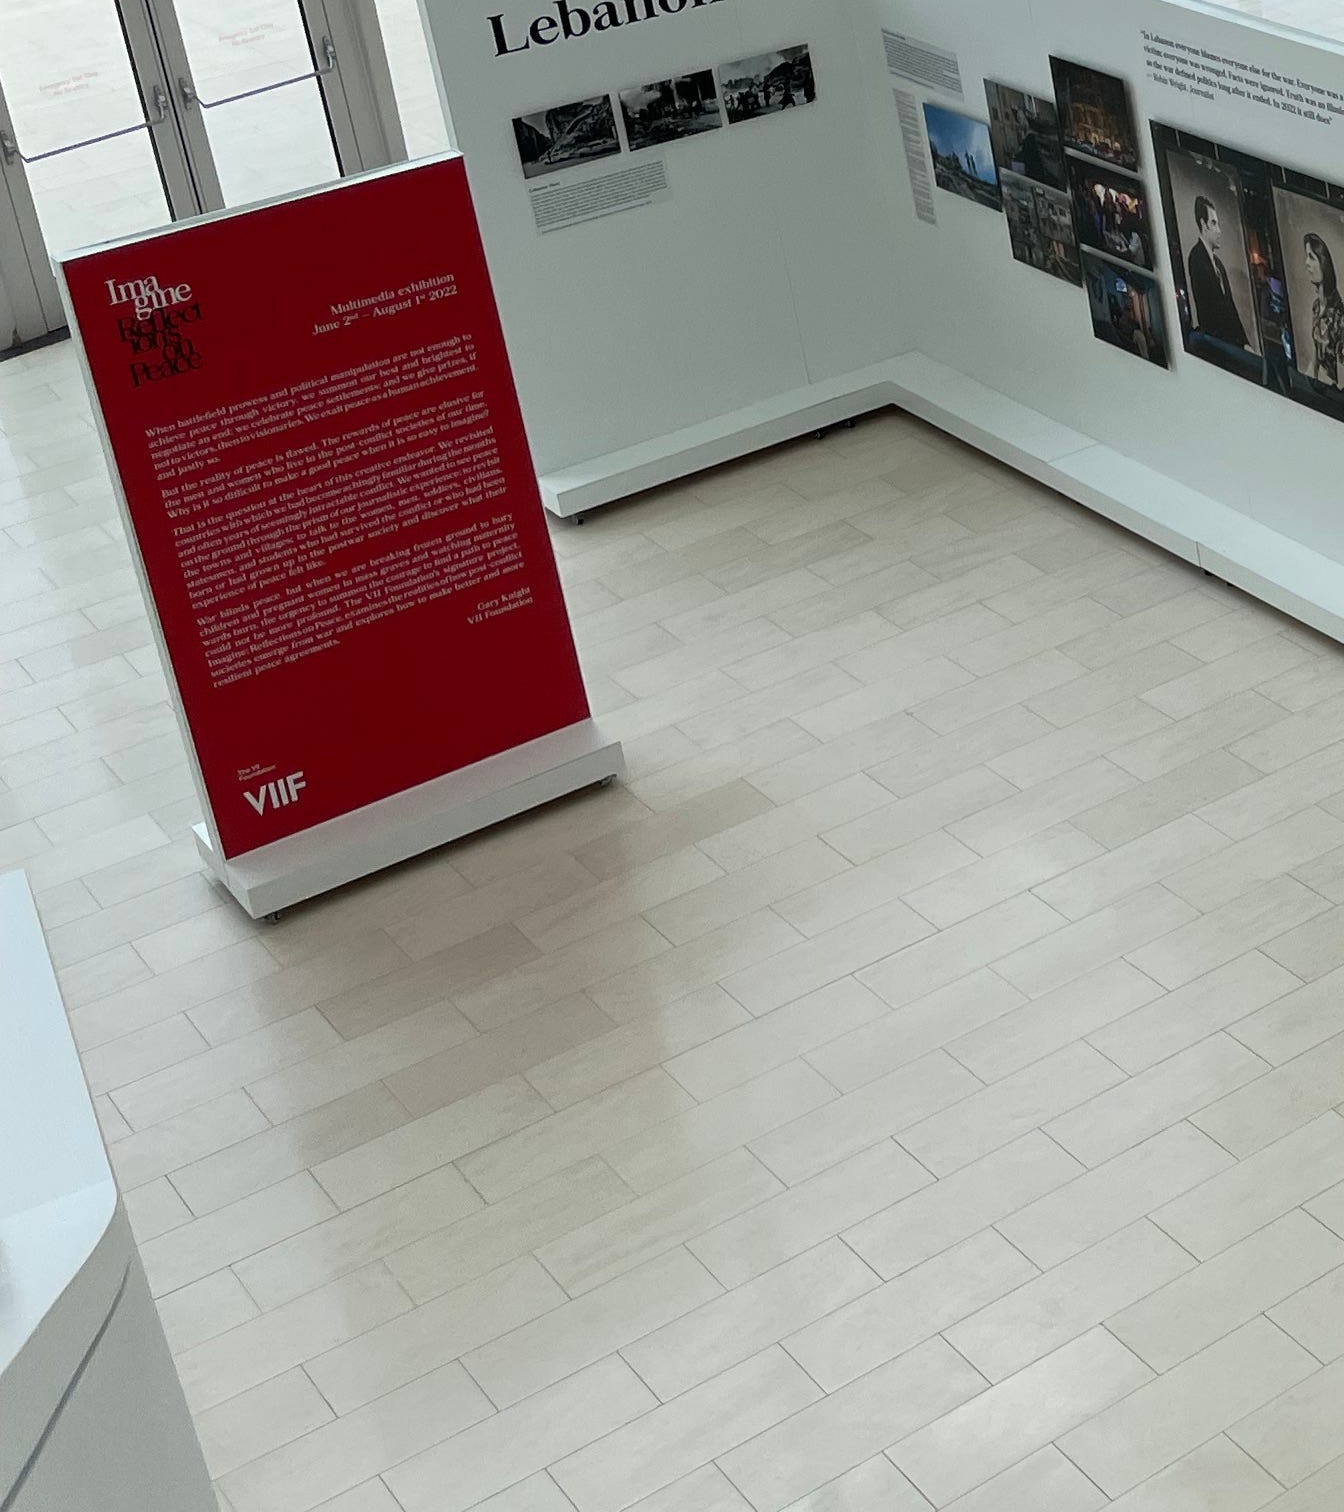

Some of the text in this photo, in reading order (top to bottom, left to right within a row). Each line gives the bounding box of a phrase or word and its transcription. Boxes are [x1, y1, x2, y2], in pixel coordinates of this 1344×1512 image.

[311, 320, 340, 335] June
[372, 298, 412, 317] August
[427, 283, 458, 301] 2022
[329, 273, 455, 316] Multimedia exhibition
[160, 390, 484, 499] But the reality of peace is flawed. The rewards of peace are elusive for
[466, 595, 533, 624] VII Foundation
[476, 585, 531, 611] Gary Knight
[242, 770, 306, 816] VIIF
